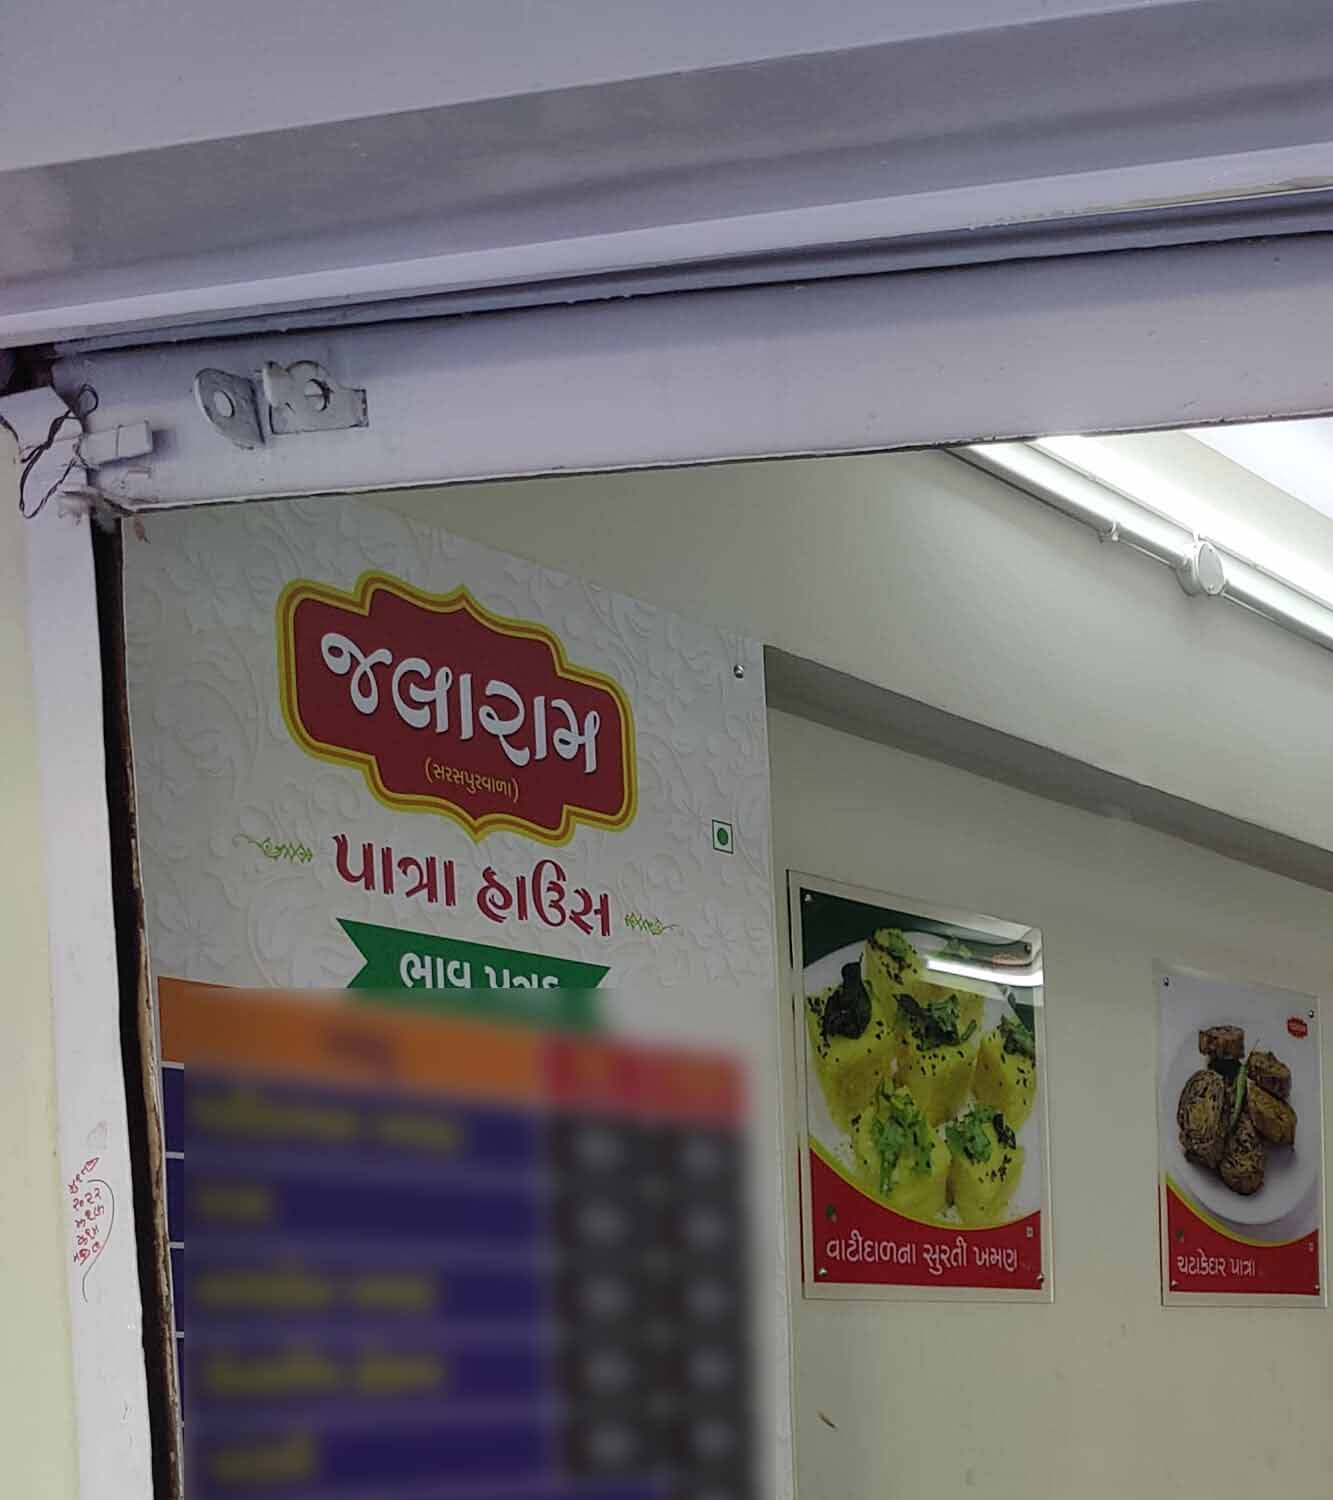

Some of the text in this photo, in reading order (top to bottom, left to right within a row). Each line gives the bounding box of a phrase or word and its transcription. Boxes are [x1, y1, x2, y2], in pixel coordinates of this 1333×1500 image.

[321, 632, 600, 773] જલારામ
[424, 757, 519, 803] (સરસપુરવાળા)
[332, 834, 611, 936] પાત્રા હાઉસ
[400, 952, 471, 988] ભાવ
[826, 1229, 1018, 1275] વાટીદાળના સુરતી ખમણ
[1230, 1257, 1256, 1277] પાત્રા
